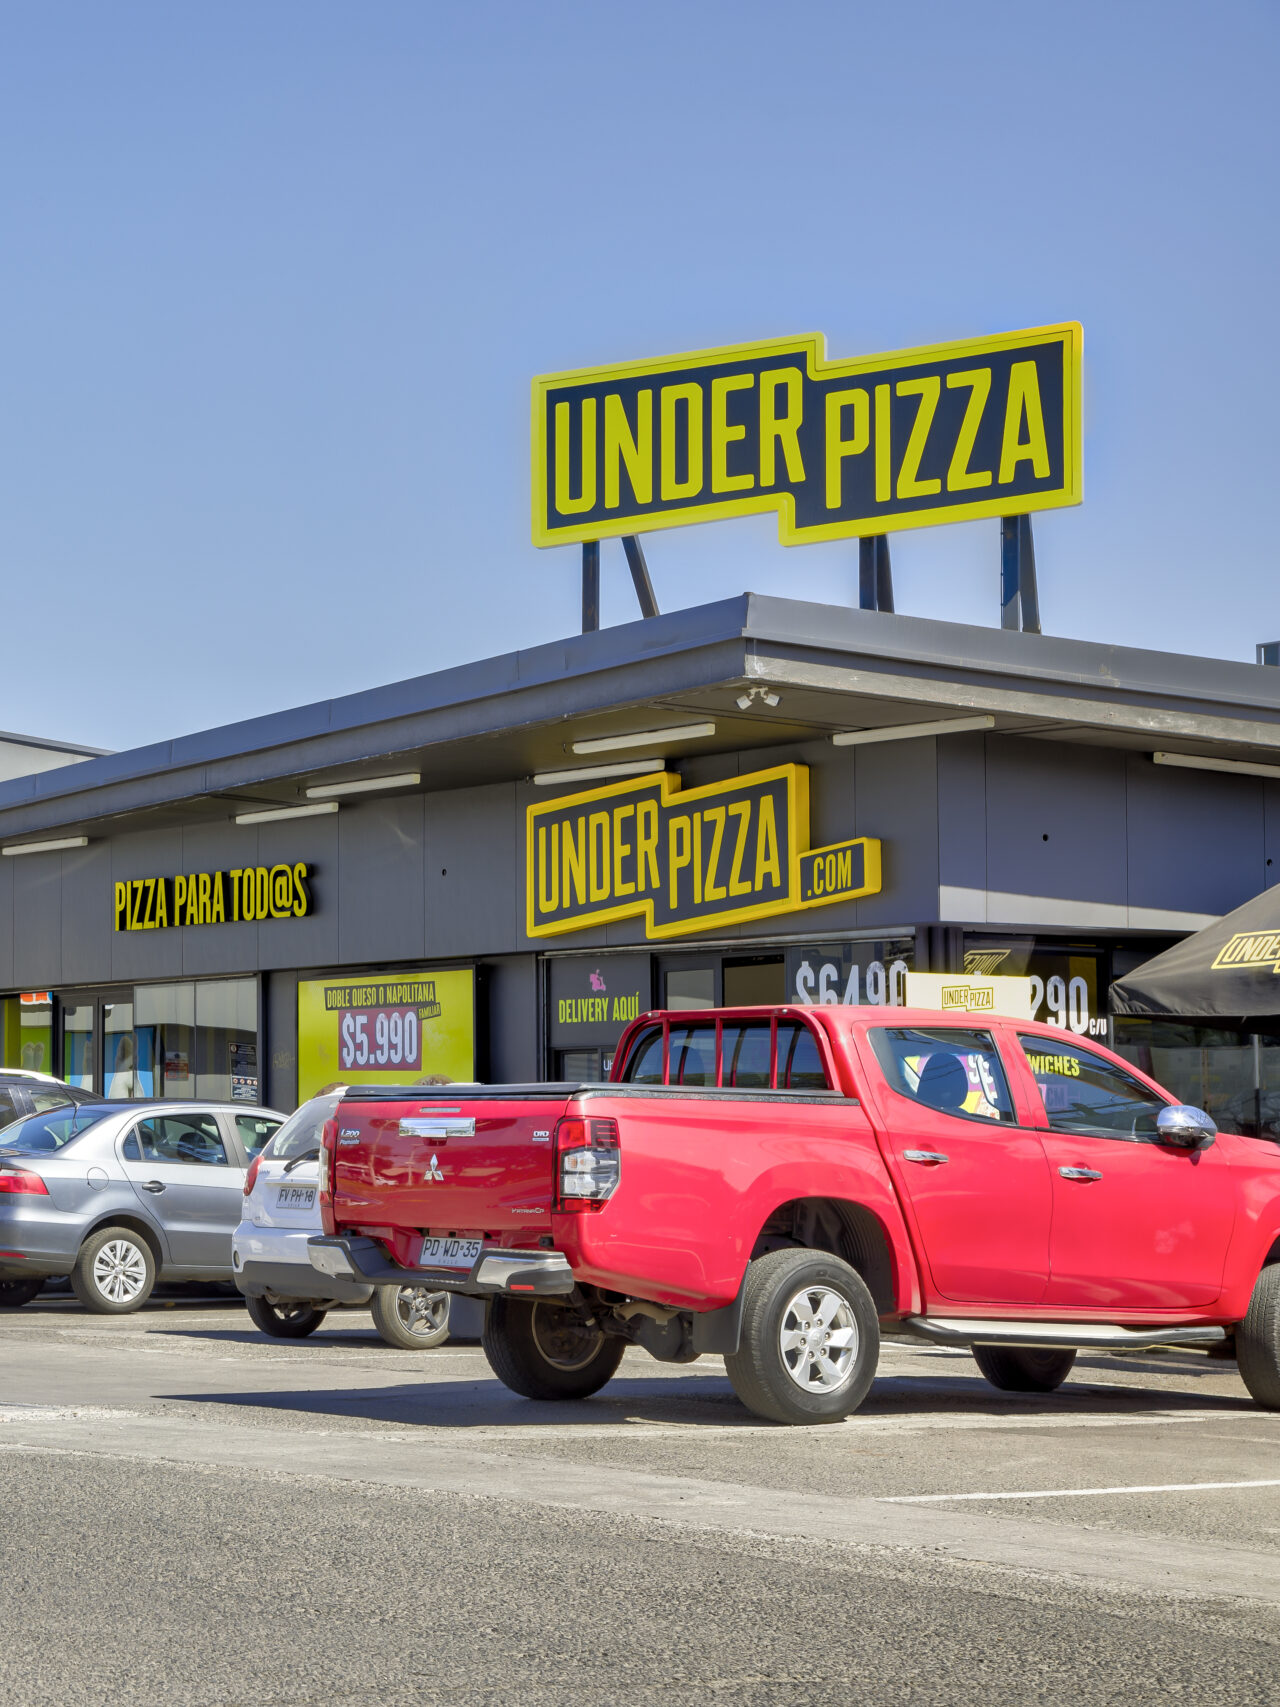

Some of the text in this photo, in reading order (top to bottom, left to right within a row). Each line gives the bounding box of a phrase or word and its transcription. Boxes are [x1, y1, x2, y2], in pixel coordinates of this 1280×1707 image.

[555, 360, 1051, 515] UNDER PIZZA
[538, 794, 852, 914] UNDER PIZZA .COM
[115, 862, 308, 932] PIZZA PARA TOD@S
[1222, 935, 1280, 963] UNDE
[327, 983, 434, 1008] DOBLE QUESO O NAPOLITANA
[558, 991, 639, 1024] DELIVERY AQUÍ
[944, 989, 992, 1008] UNDER PIZZA
[342, 1012, 418, 1068] $5.990
[1089, 1018, 1108, 1036] C/U
